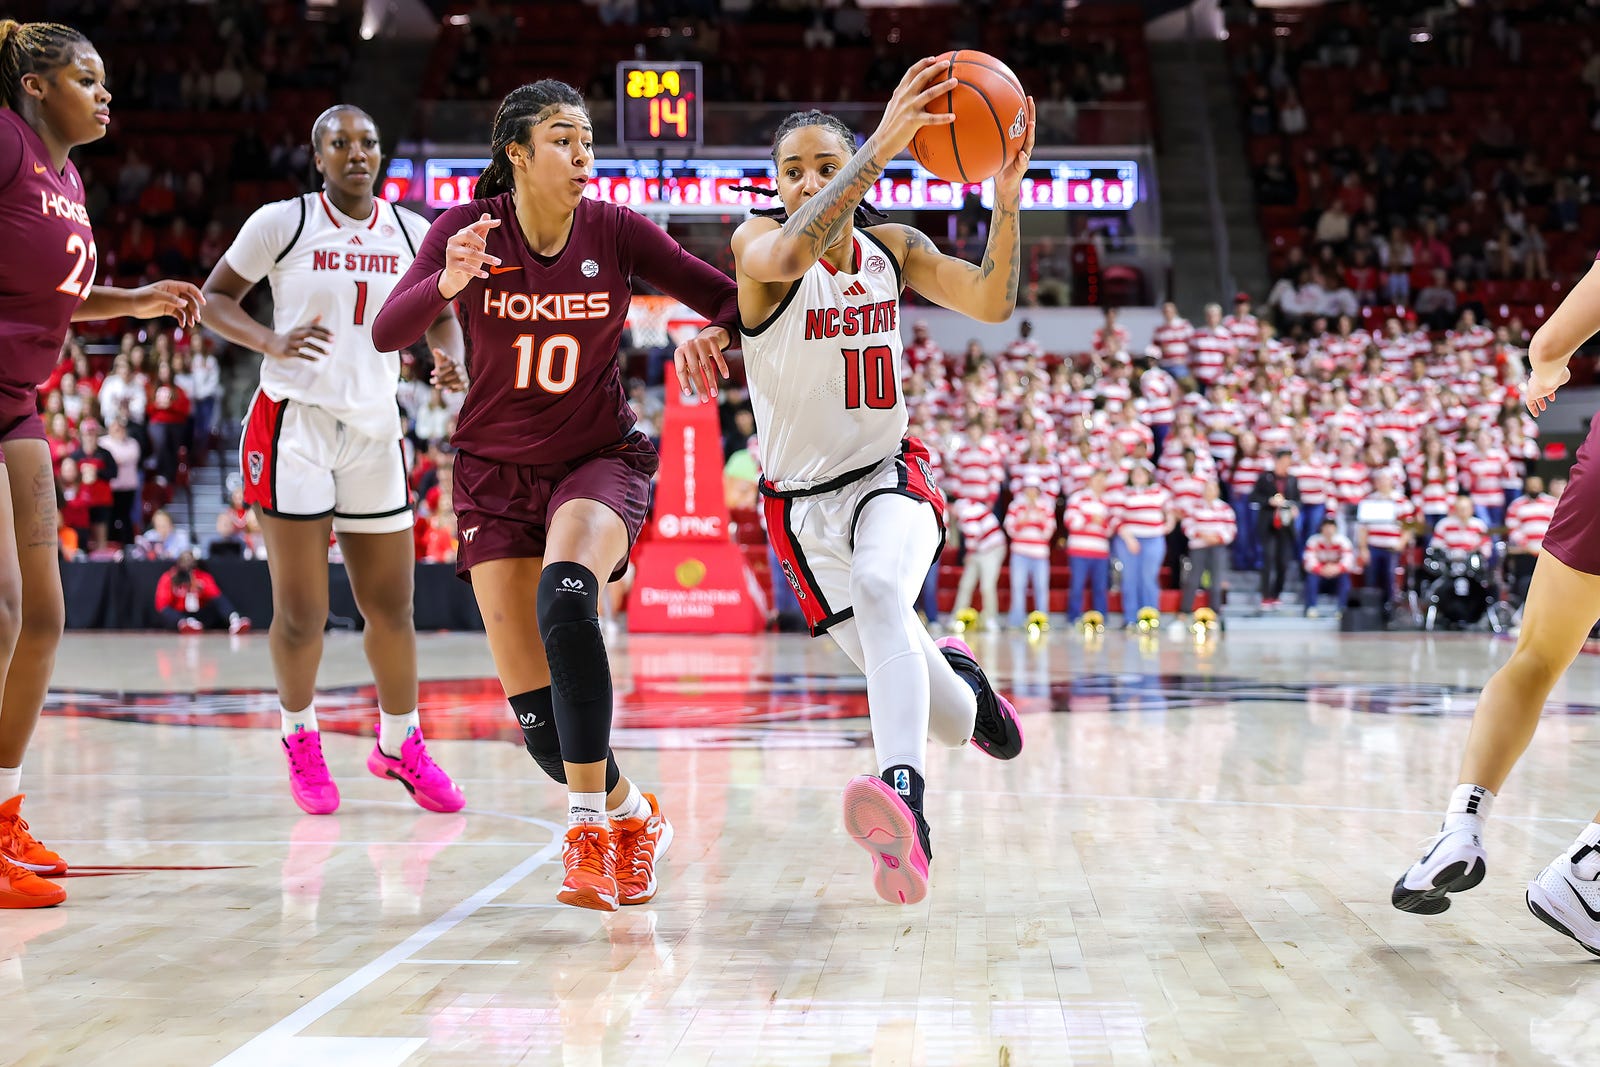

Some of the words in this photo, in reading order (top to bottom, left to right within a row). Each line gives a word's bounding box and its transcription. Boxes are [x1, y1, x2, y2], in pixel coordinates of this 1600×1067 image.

[649, 97, 688, 138] 14
[313, 250, 340, 271] NC
[345, 253, 399, 274] STATE
[354, 280, 368, 326] 1
[484, 288, 610, 321] HOKIES
[805, 307, 840, 340] NC
[842, 299, 896, 336] STATE
[511, 333, 581, 395] 10
[841, 344, 897, 410] 10
[681, 516, 722, 537] PNC
